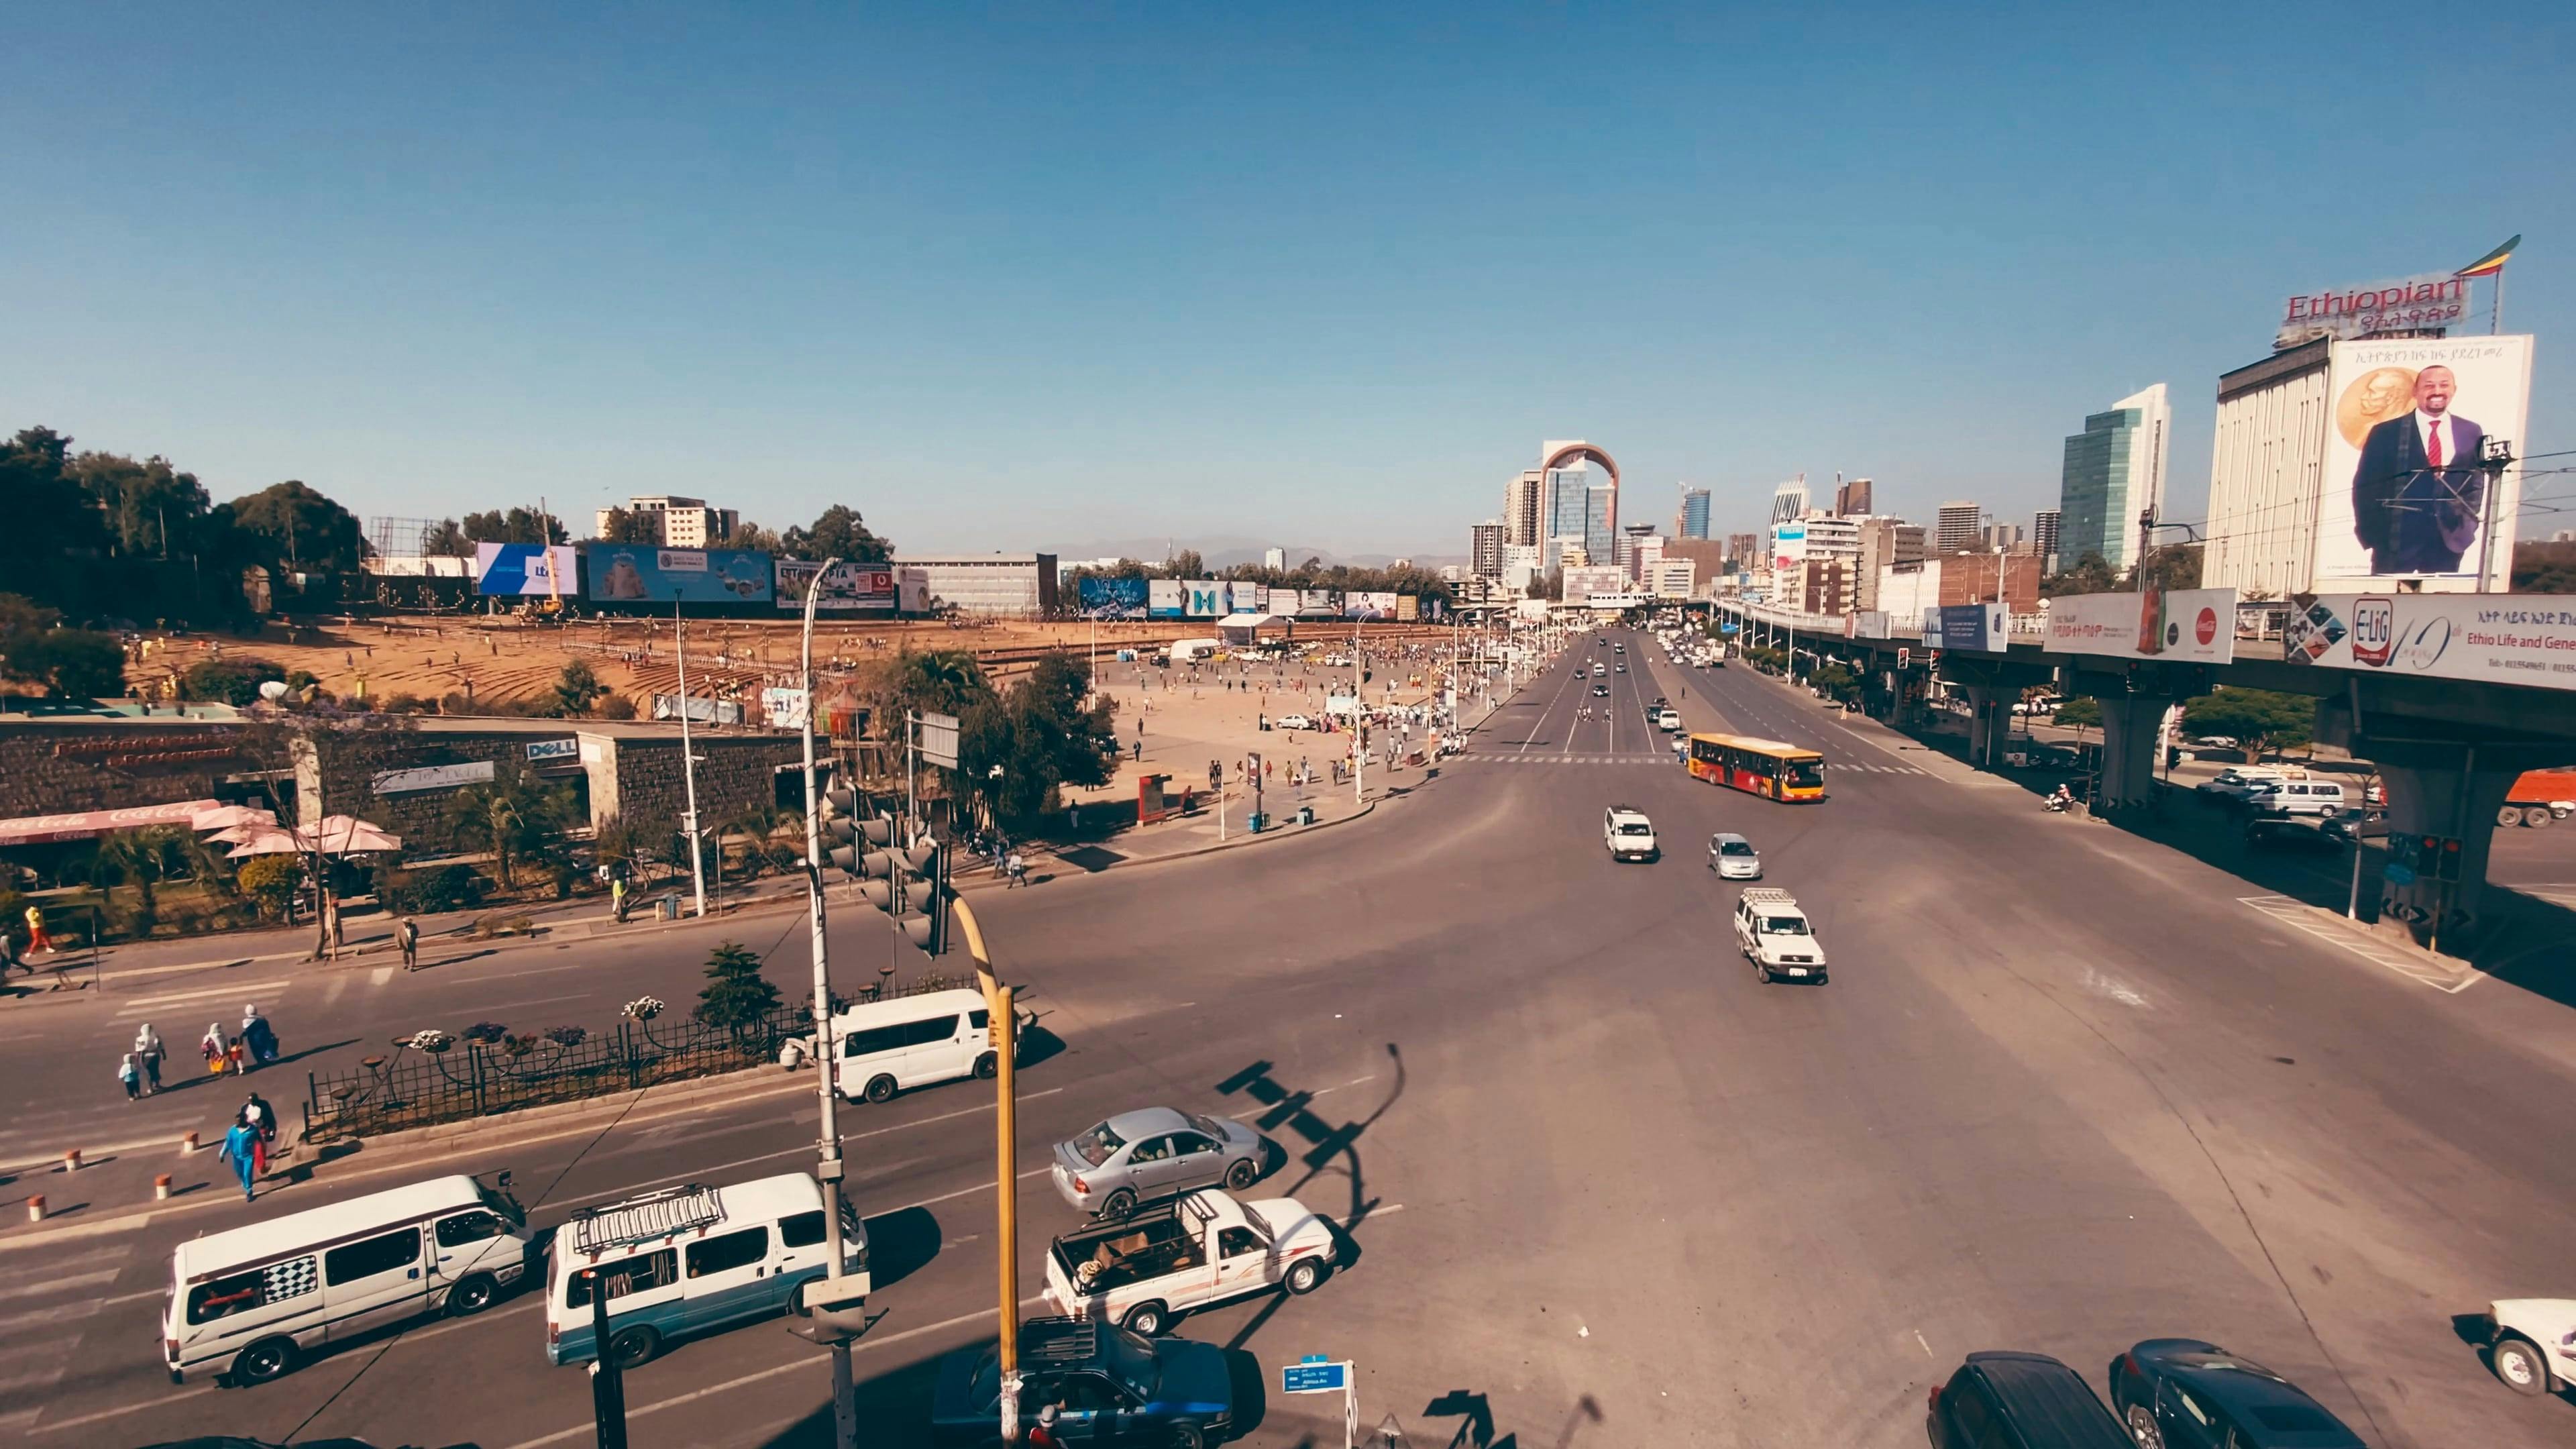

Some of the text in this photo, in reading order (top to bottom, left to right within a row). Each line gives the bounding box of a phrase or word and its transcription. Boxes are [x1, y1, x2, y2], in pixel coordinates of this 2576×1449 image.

[2288, 278, 2461, 319] Ethiopian
[2467, 633, 2495, 645] Ethio
[2498, 634, 2518, 647] Life
[2520, 635, 2542, 649] and
[528, 741, 576, 757] DELL
